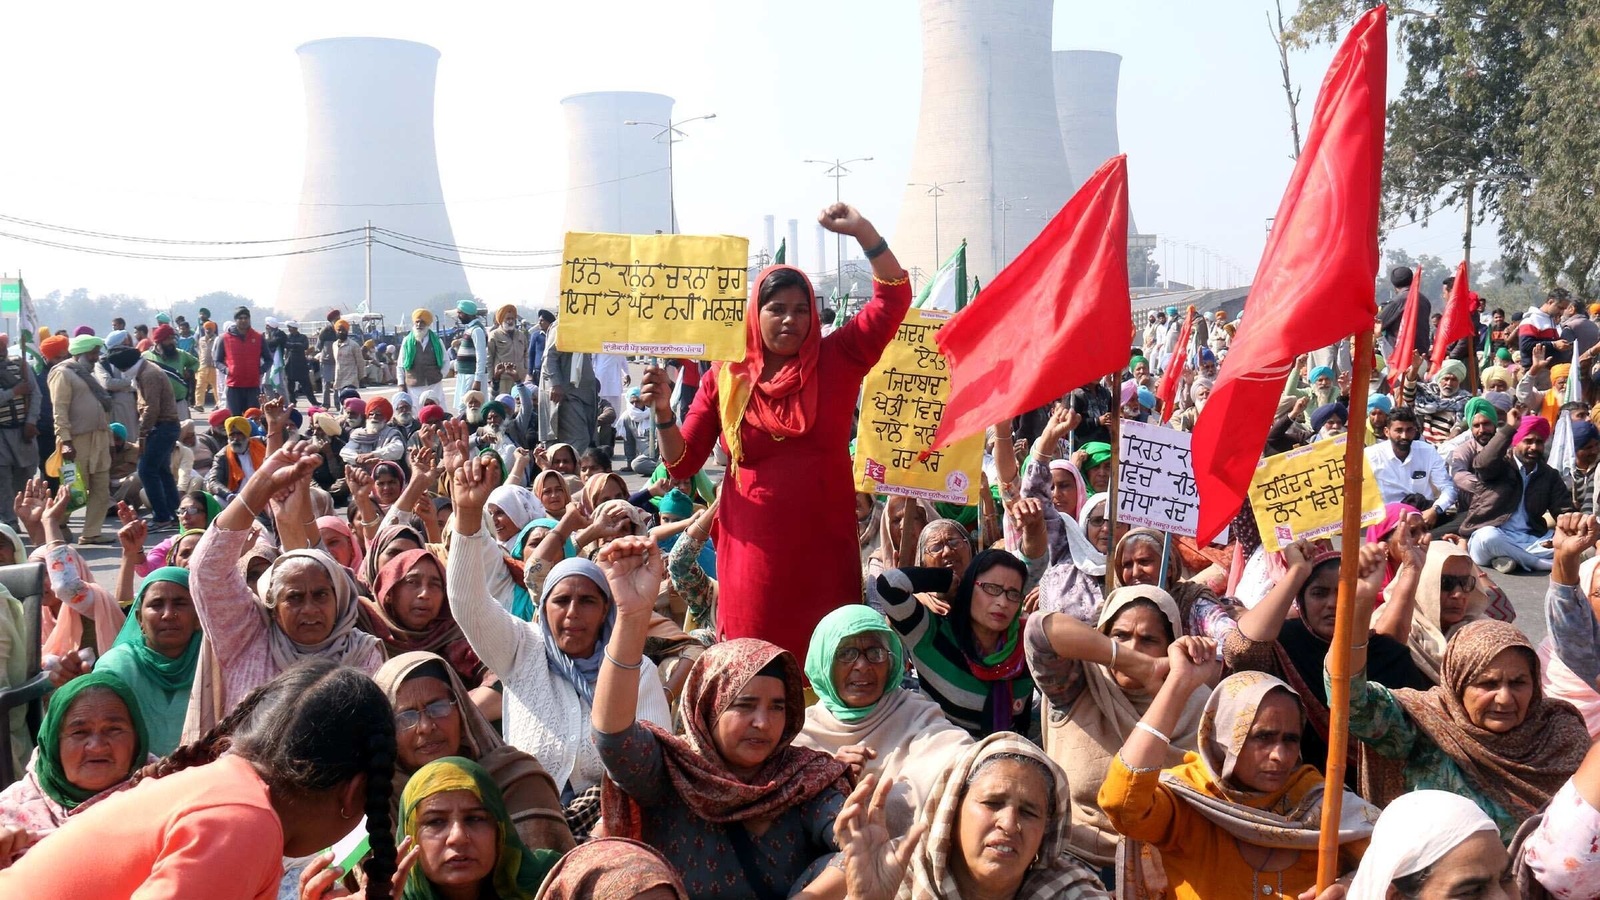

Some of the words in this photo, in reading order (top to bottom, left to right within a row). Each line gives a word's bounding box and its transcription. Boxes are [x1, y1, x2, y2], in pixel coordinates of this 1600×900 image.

[561, 289, 603, 315] ਇਸ
[914, 345, 946, 370] ਏਕਤ
[912, 397, 946, 421] ਵਿਰੋ
[1122, 435, 1171, 461] ਕਿਰਤ
[1305, 485, 1344, 511] ਵਿਰੋ
